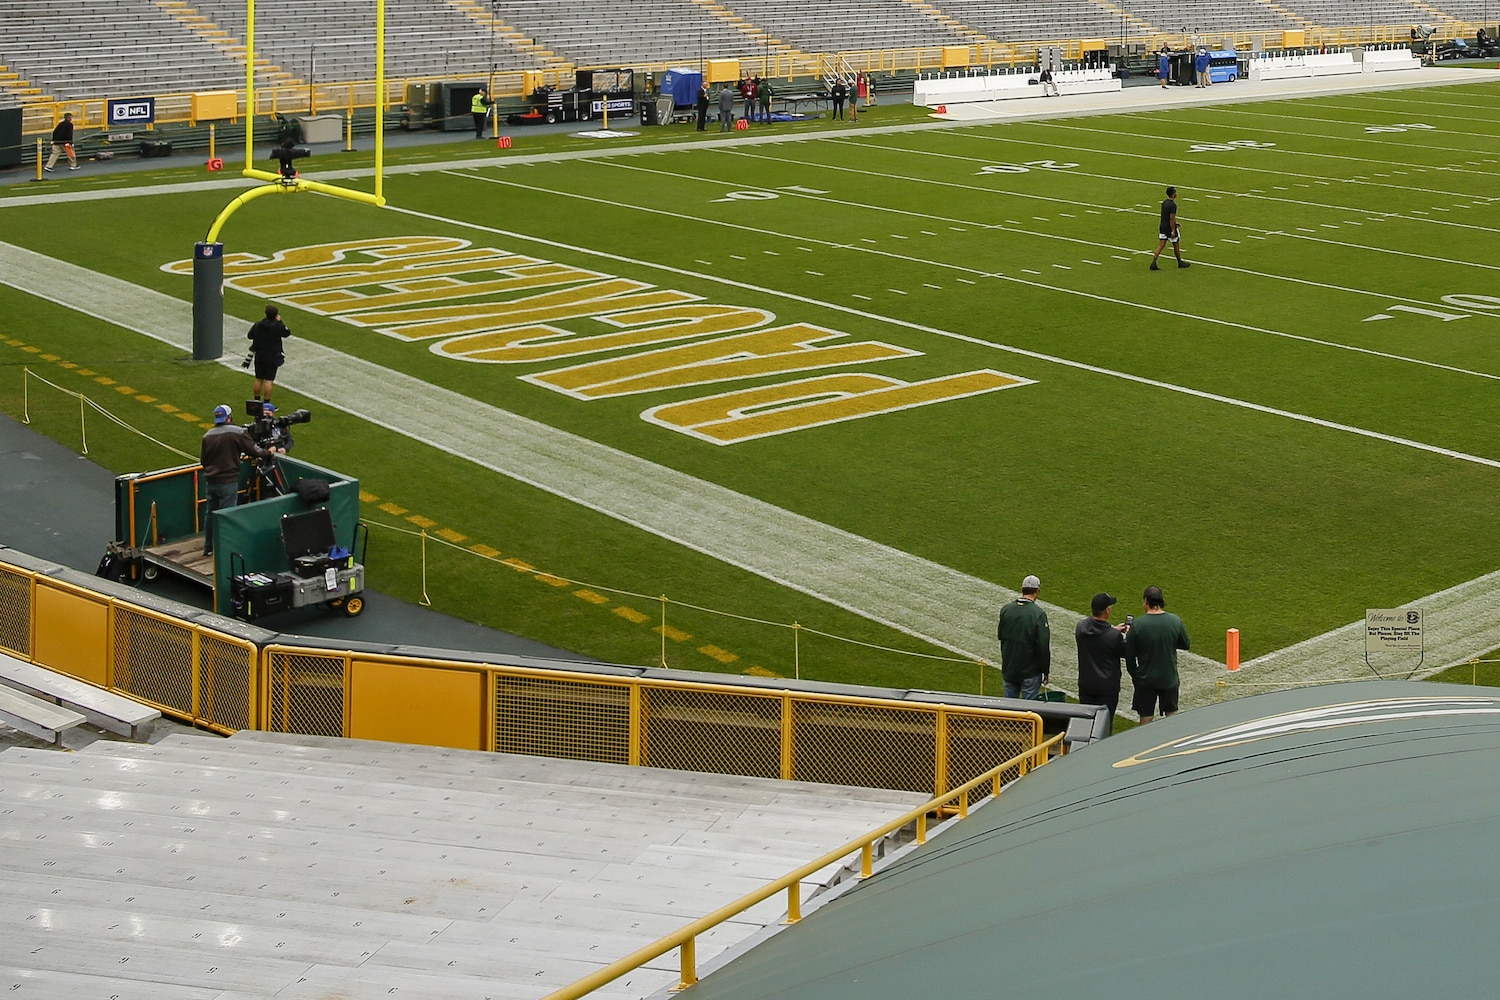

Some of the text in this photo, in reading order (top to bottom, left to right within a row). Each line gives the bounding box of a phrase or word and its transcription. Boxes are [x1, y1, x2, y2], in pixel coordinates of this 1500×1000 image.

[129, 107, 146, 116] NFL
[500, 137, 510, 147] 10
[160, 236, 1039, 447] PACKERS
[1368, 613, 1396, 622] Welcome
